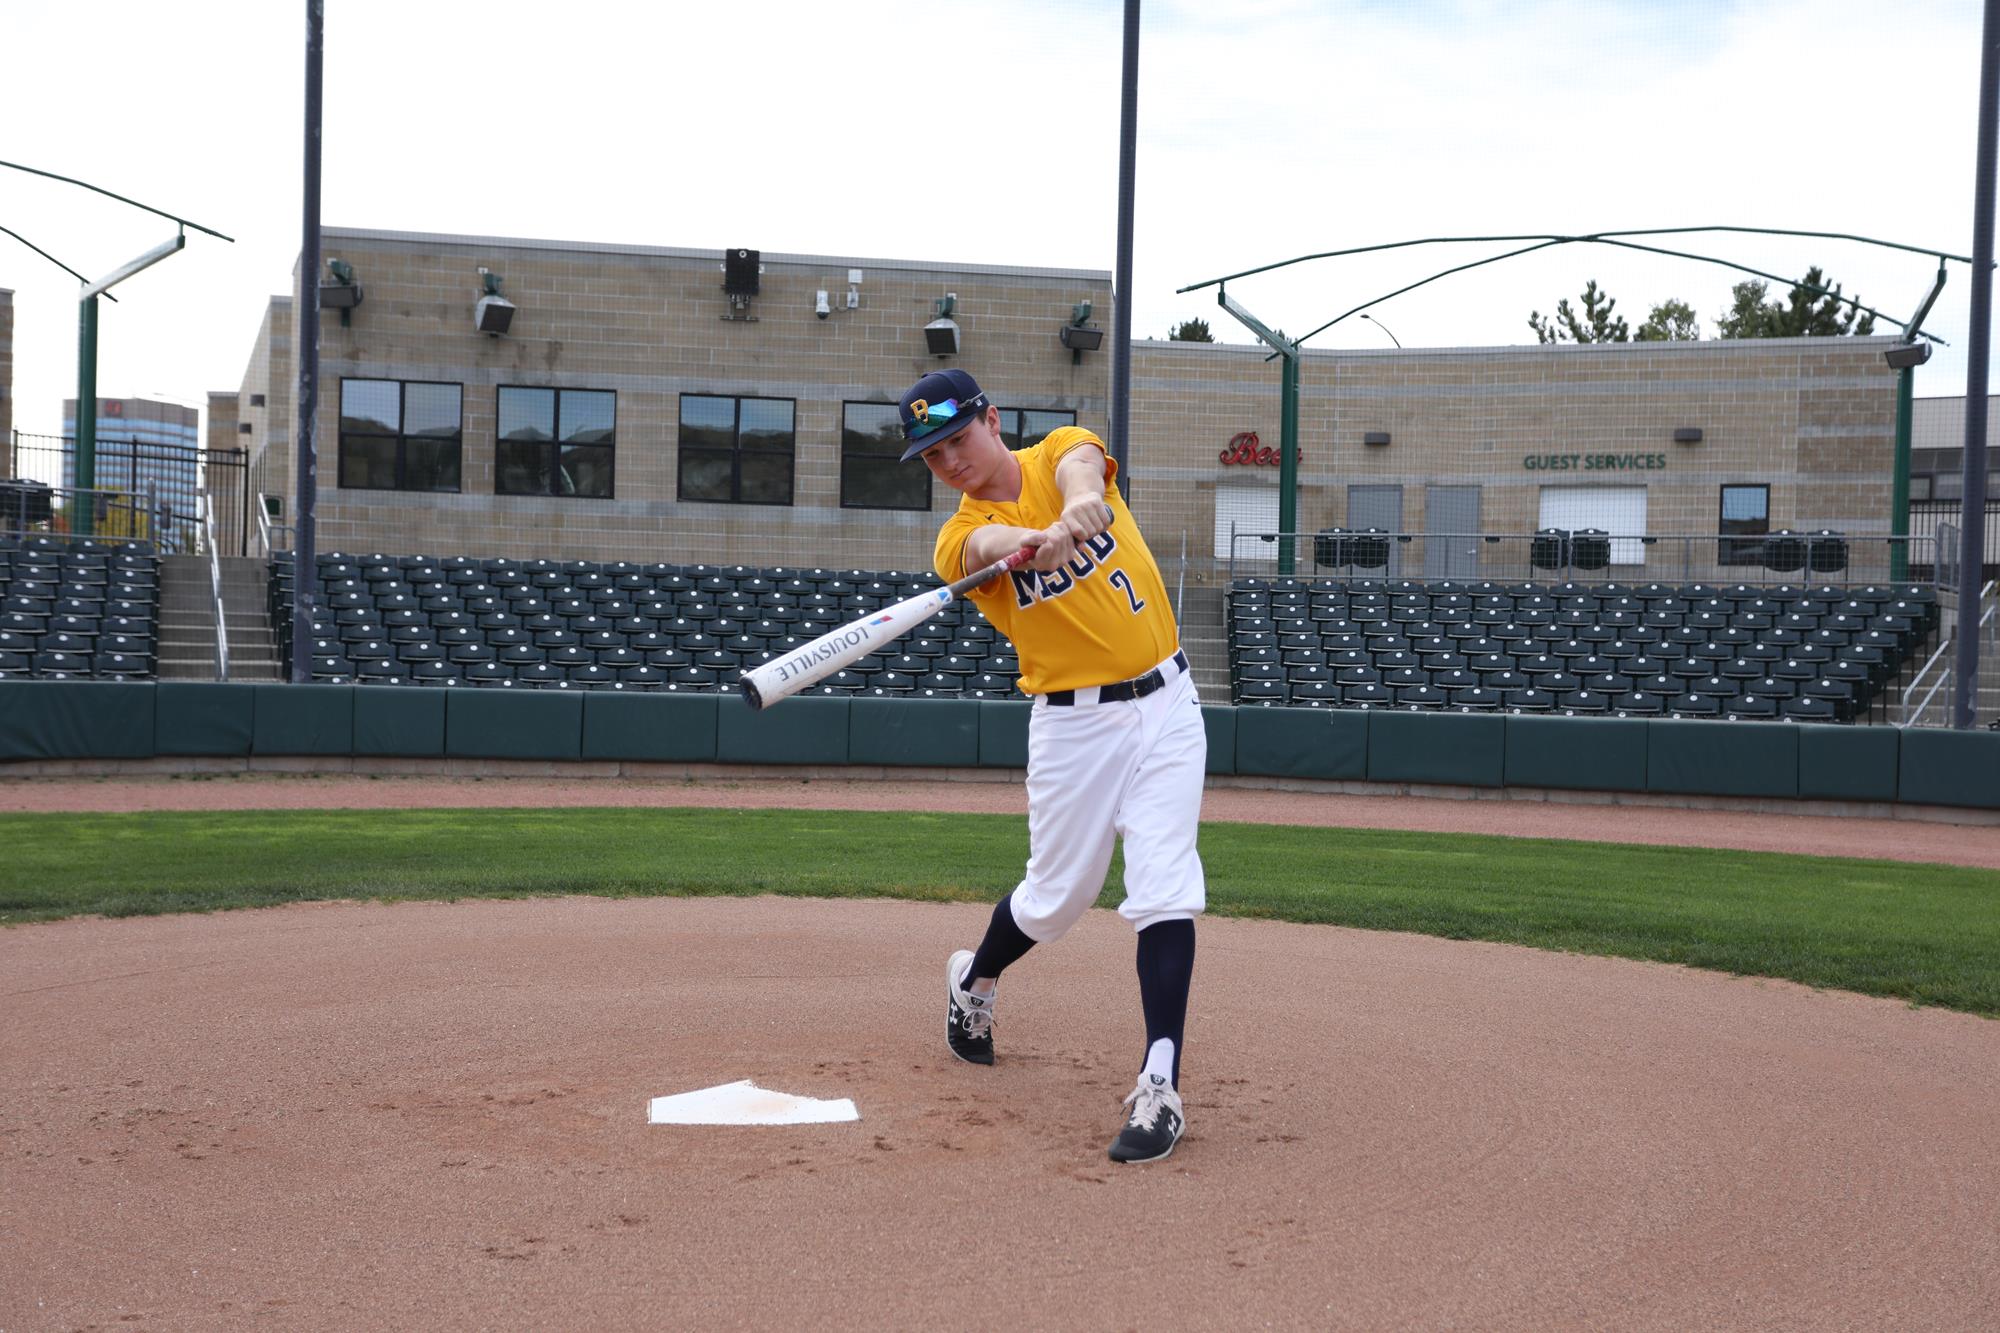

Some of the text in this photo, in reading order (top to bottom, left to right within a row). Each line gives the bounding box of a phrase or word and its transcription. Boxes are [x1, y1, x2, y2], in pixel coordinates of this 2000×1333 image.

[1219, 431, 1303, 465] Bee
[1524, 454, 1666, 470] GUEST SERVICES
[1108, 568, 1145, 615] 2
[774, 626, 870, 682] LOUISVILLE
